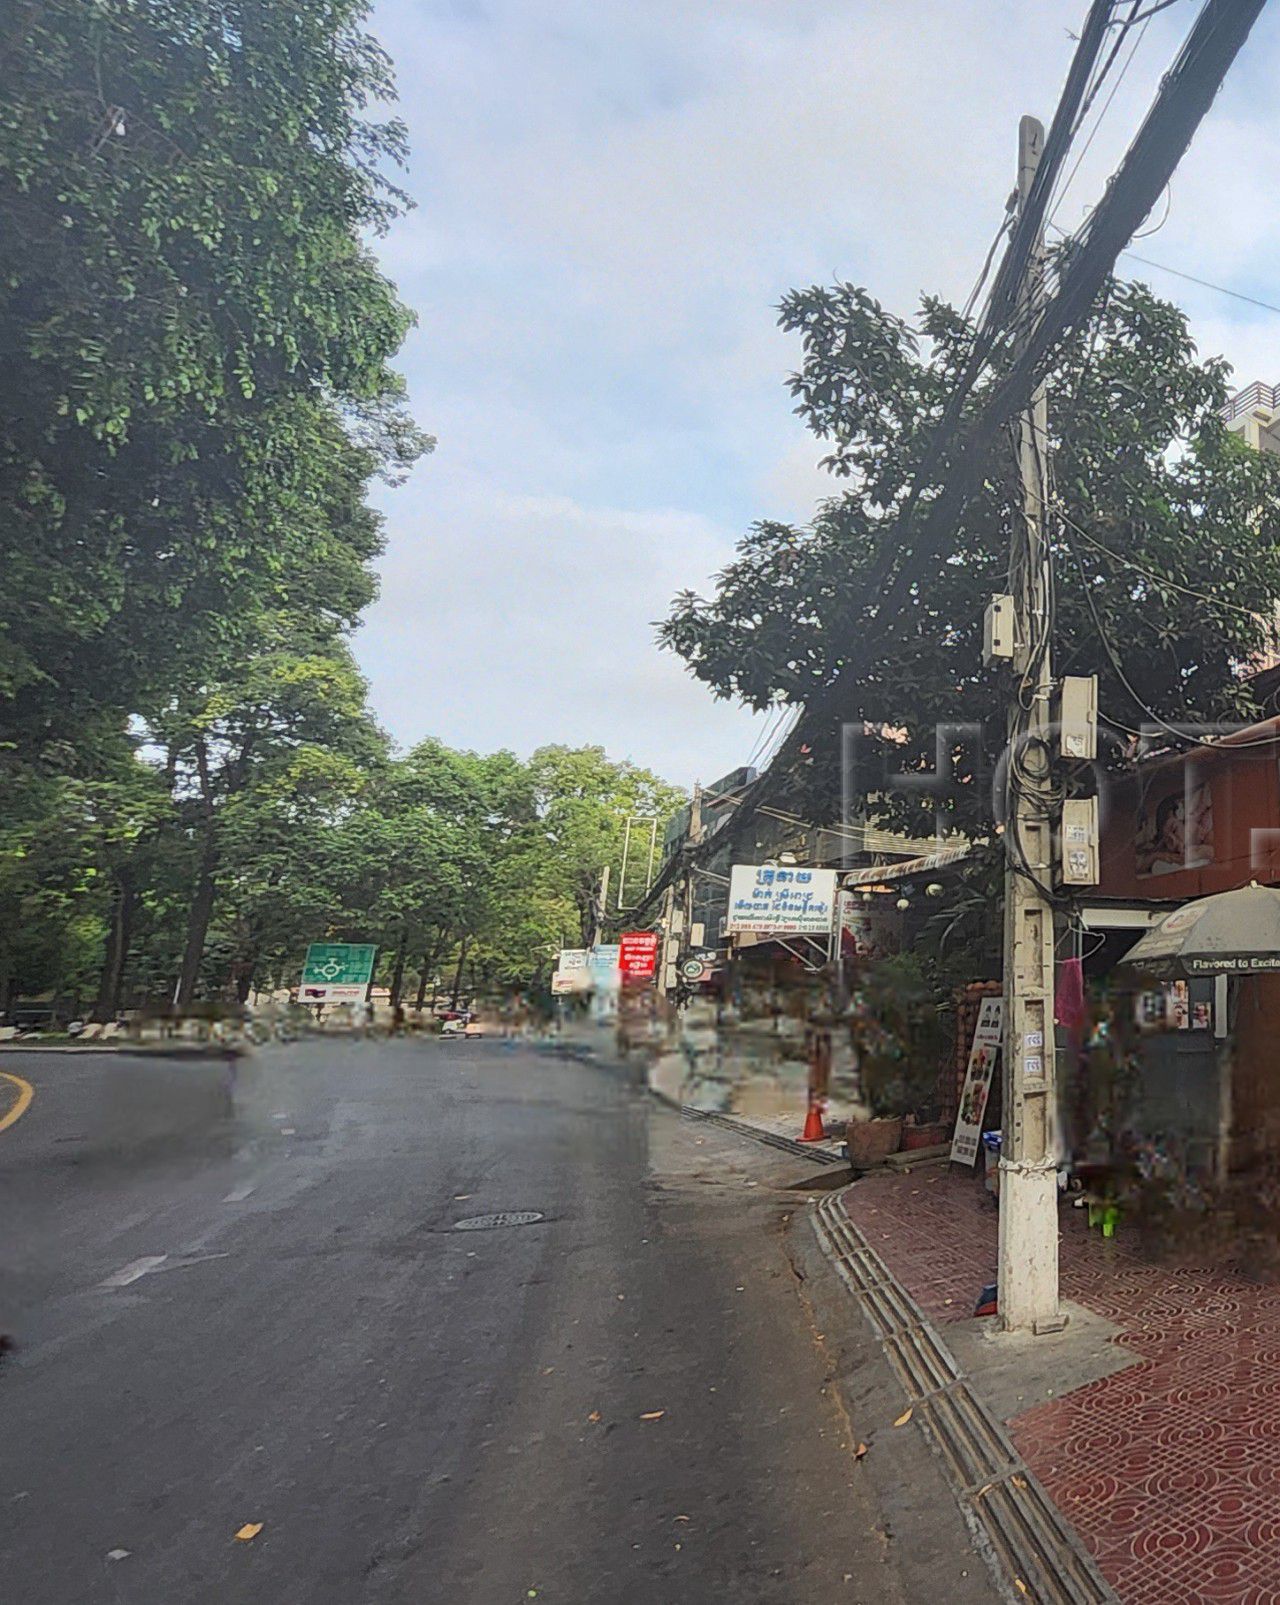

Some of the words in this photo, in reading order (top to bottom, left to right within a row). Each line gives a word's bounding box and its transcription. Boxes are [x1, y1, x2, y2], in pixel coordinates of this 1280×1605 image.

[1193, 958, 1237, 969] Flavored
[1238, 959, 1249, 968] to
[1250, 958, 1280, 968] Excite
